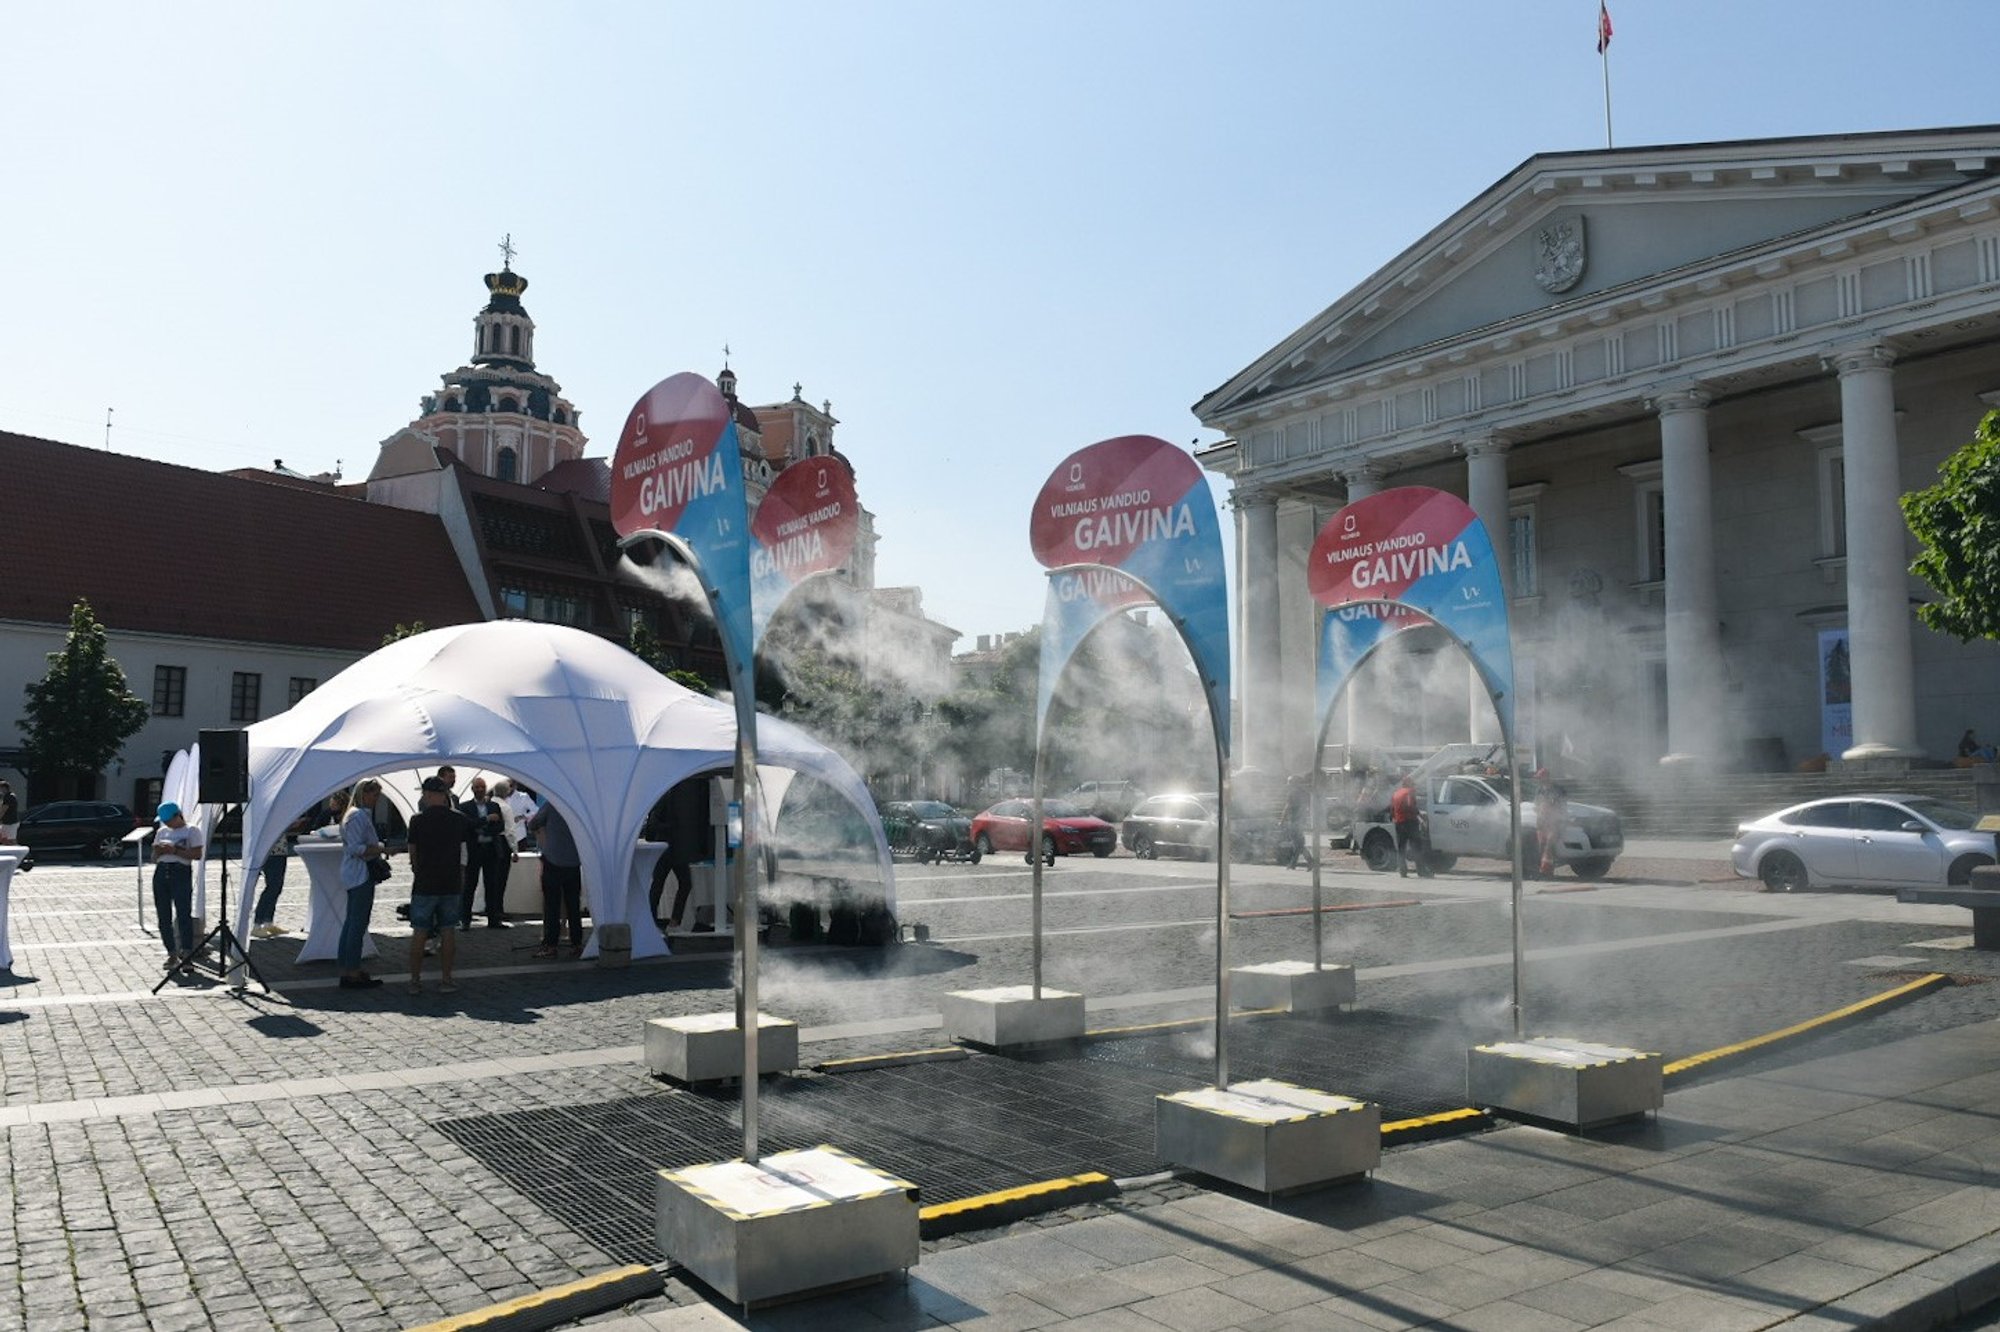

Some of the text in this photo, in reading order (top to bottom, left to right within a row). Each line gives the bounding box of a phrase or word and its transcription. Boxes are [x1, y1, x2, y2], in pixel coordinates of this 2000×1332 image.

[623, 438, 694, 480] VILNIAUS VANDUO
[640, 451, 726, 516] GAIVINA
[1051, 489, 1150, 519] VILNIAUS VANDUO
[1074, 503, 1196, 551] GAIVINA
[1326, 542, 1373, 564] VILNIAUS
[1375, 532, 1426, 553] VANDUO
[753, 529, 824, 578] GAIVINA
[1351, 541, 1473, 589] GAIVINA
